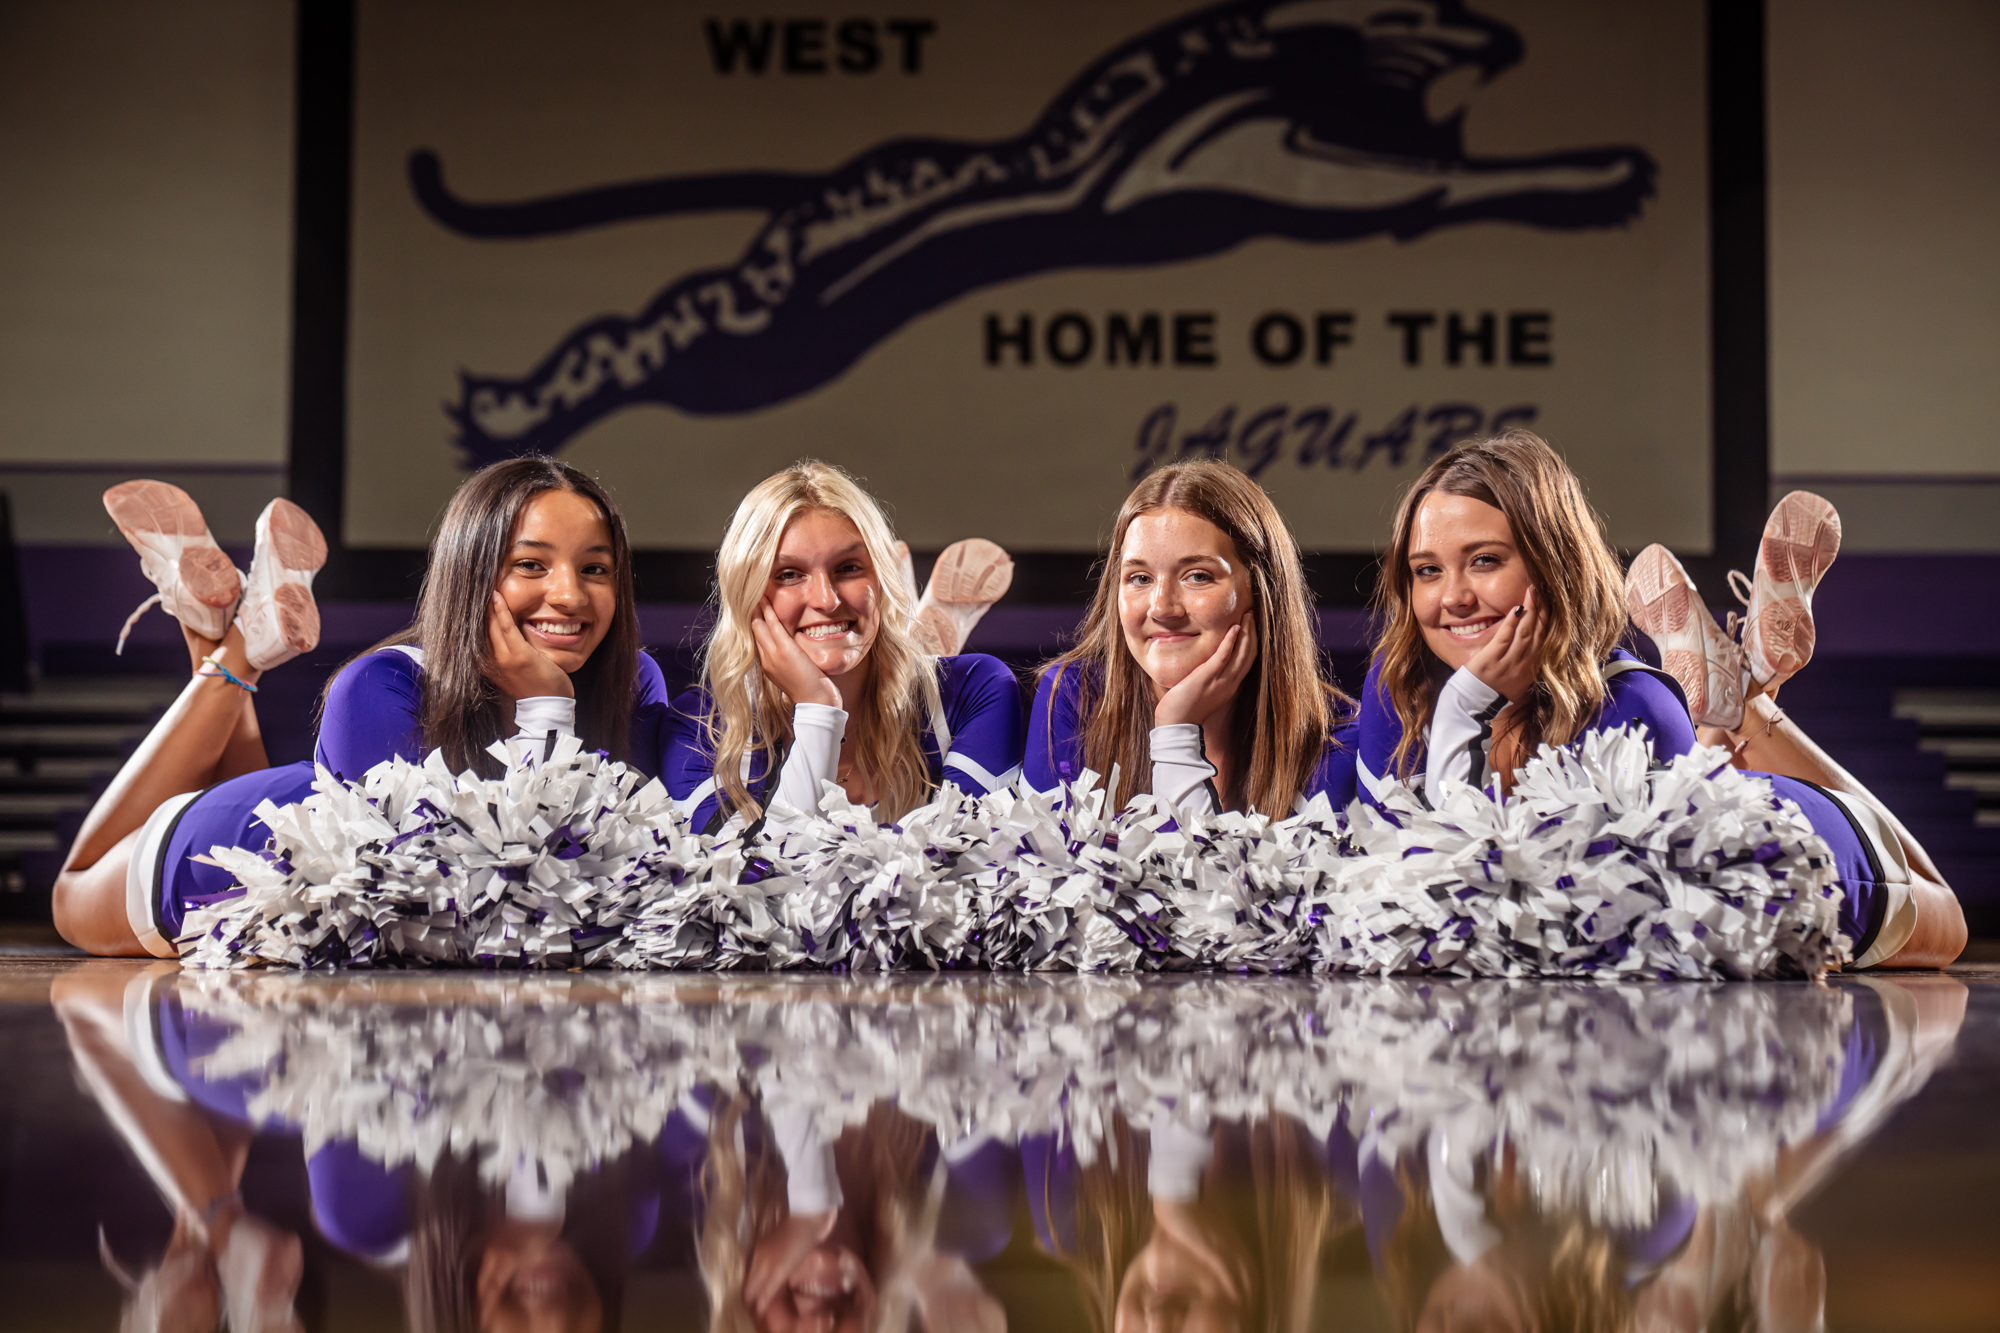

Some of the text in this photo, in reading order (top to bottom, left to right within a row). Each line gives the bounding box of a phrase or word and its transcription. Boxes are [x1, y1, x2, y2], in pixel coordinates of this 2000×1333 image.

[705, 17, 937, 75] WEST
[984, 312, 1555, 367] HOME OF THE
